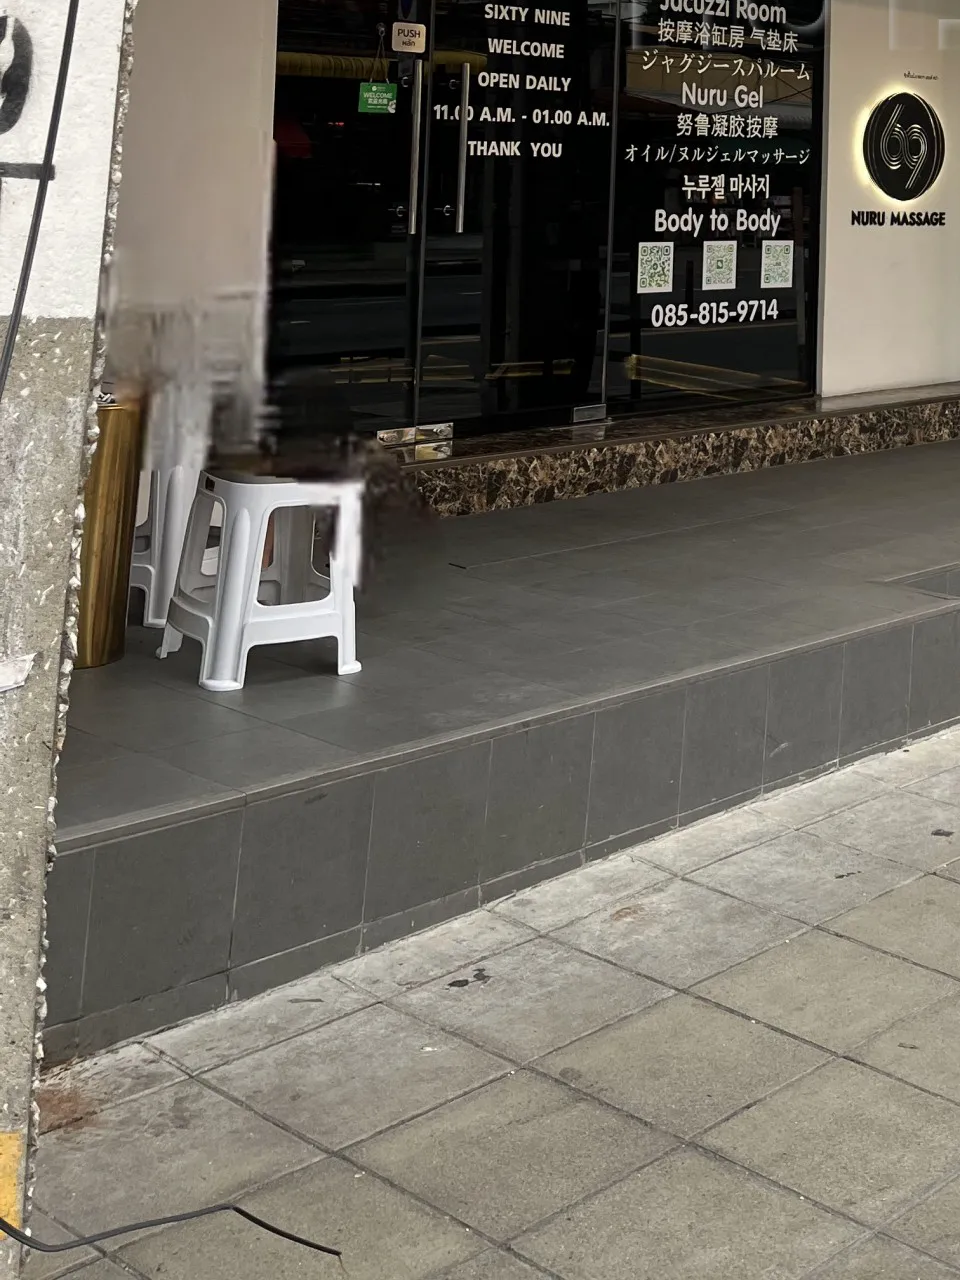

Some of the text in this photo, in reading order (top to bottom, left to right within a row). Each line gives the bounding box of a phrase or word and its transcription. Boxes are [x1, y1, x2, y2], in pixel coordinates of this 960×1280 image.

[484, 4, 571, 27] SIXTY NINE
[397, 29, 420, 38] PUSH
[658, 18, 799, 54] 按摩浴缸房 气垫床
[487, 38, 565, 59] WELCOME
[642, 48, 810, 81] ジャグジースパルーム
[477, 71, 571, 92] OPEN DAILY
[681, 81, 764, 108] Nuru Gel
[479, 106, 516, 122] A.M.
[532, 109, 572, 125] 01.00
[577, 111, 610, 126] A.M.
[676, 113, 779, 139] 努鲁凝胶按摩
[468, 141, 563, 158] THANK YOU
[624, 143, 811, 165] オイル/ヌルジェルマッサージ
[681, 173, 770, 200] 누루젤 마사지
[654, 207, 781, 238] Body to Body
[851, 210, 946, 227] NURU MASSAGE
[651, 298, 779, 328] 085-815-9714
